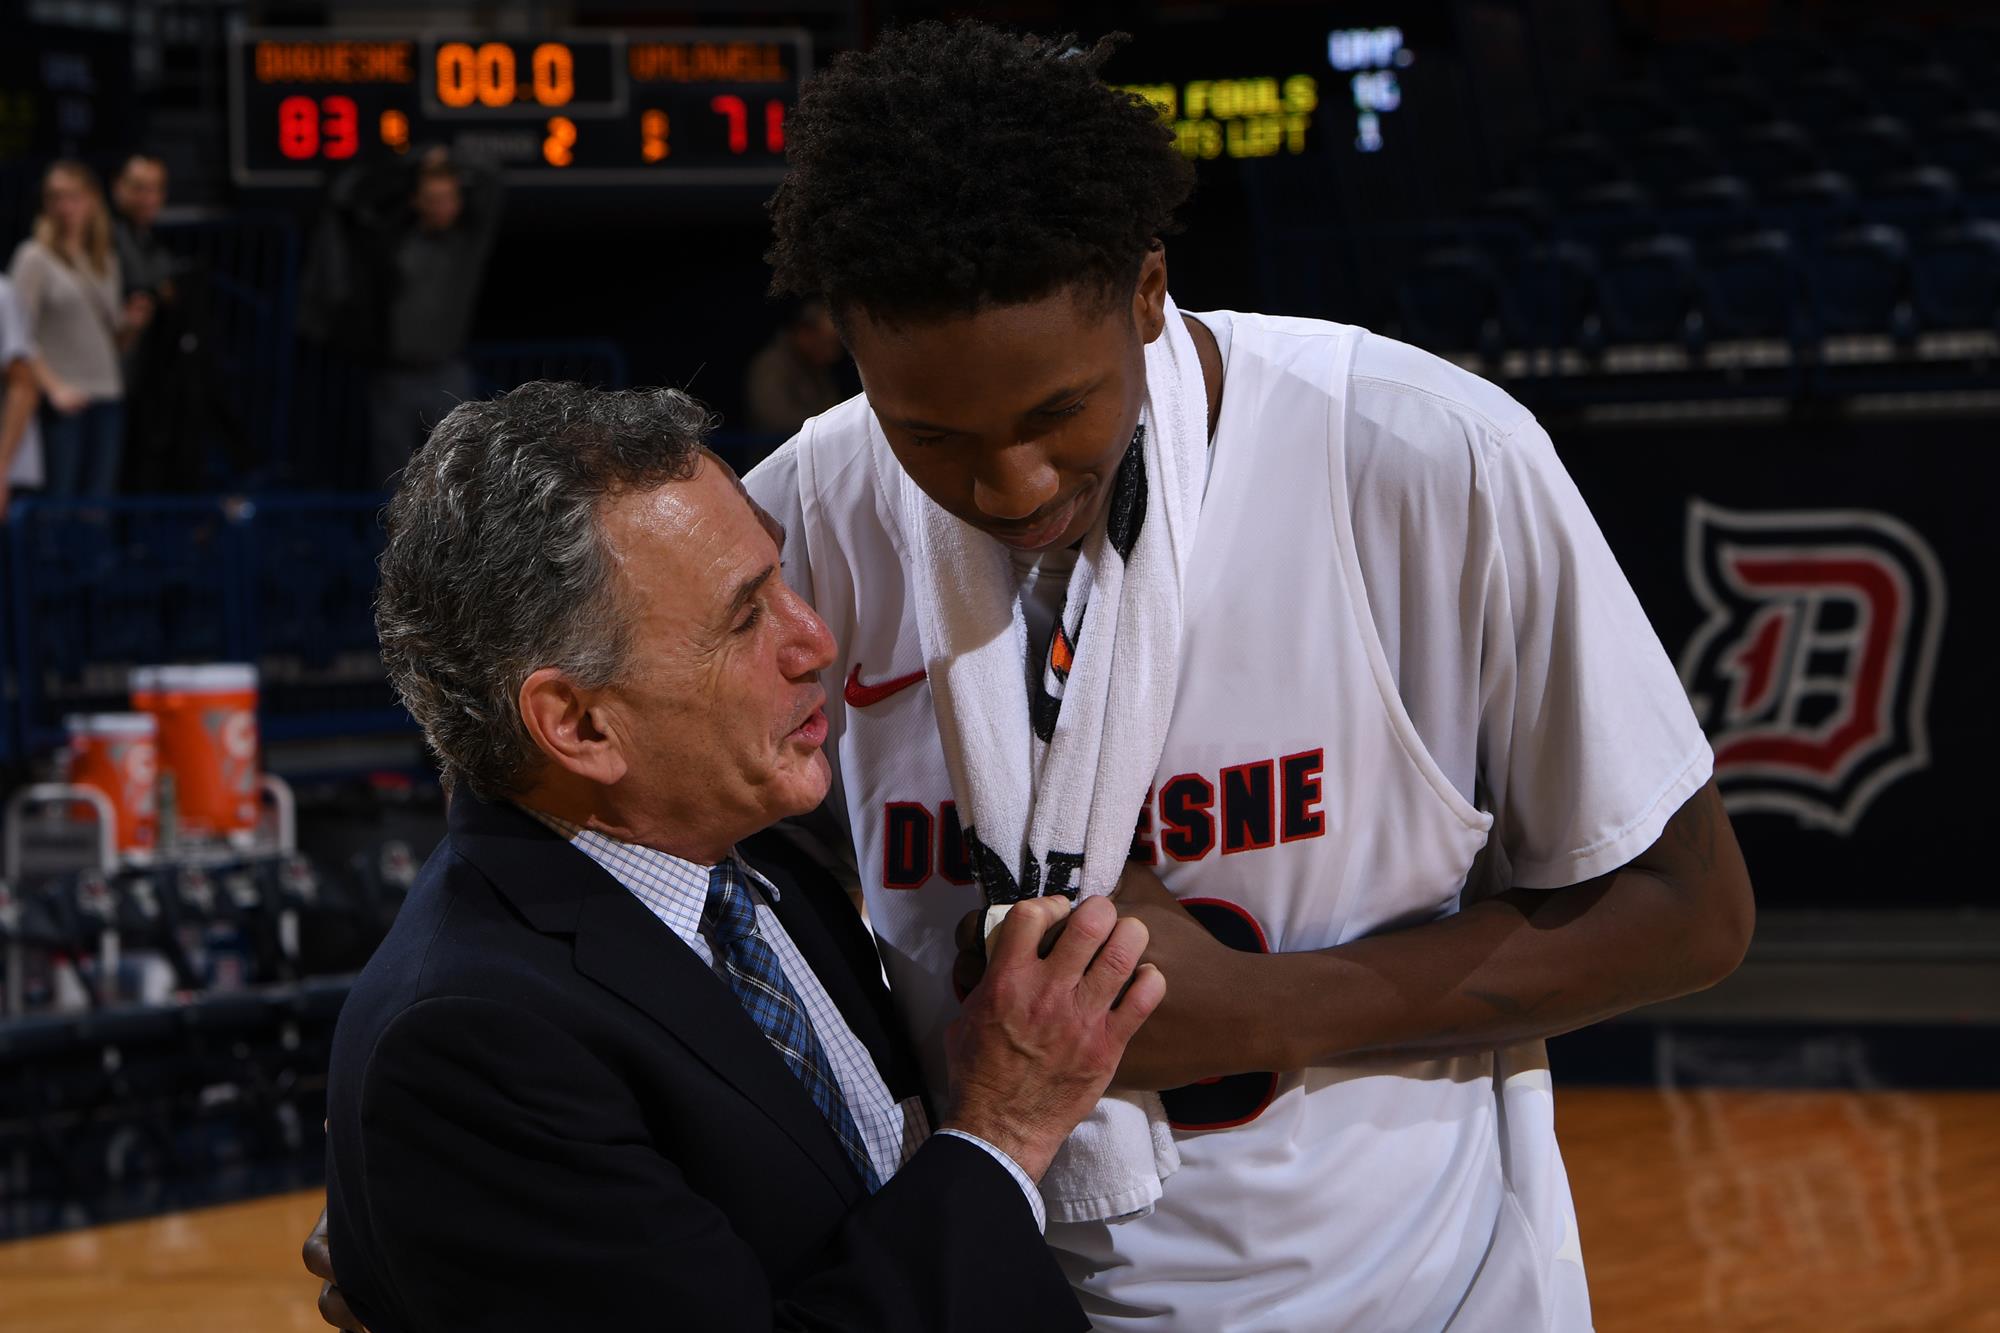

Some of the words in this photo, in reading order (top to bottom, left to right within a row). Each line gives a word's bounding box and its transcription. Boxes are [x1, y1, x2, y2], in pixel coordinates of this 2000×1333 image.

[437, 42, 574, 107] 00.0
[1184, 75, 1317, 119] FOULS
[279, 95, 358, 160] 83
[542, 116, 577, 167] 2
[1227, 114, 1310, 158] LEFT
[883, 748, 1325, 889] DUSNE
